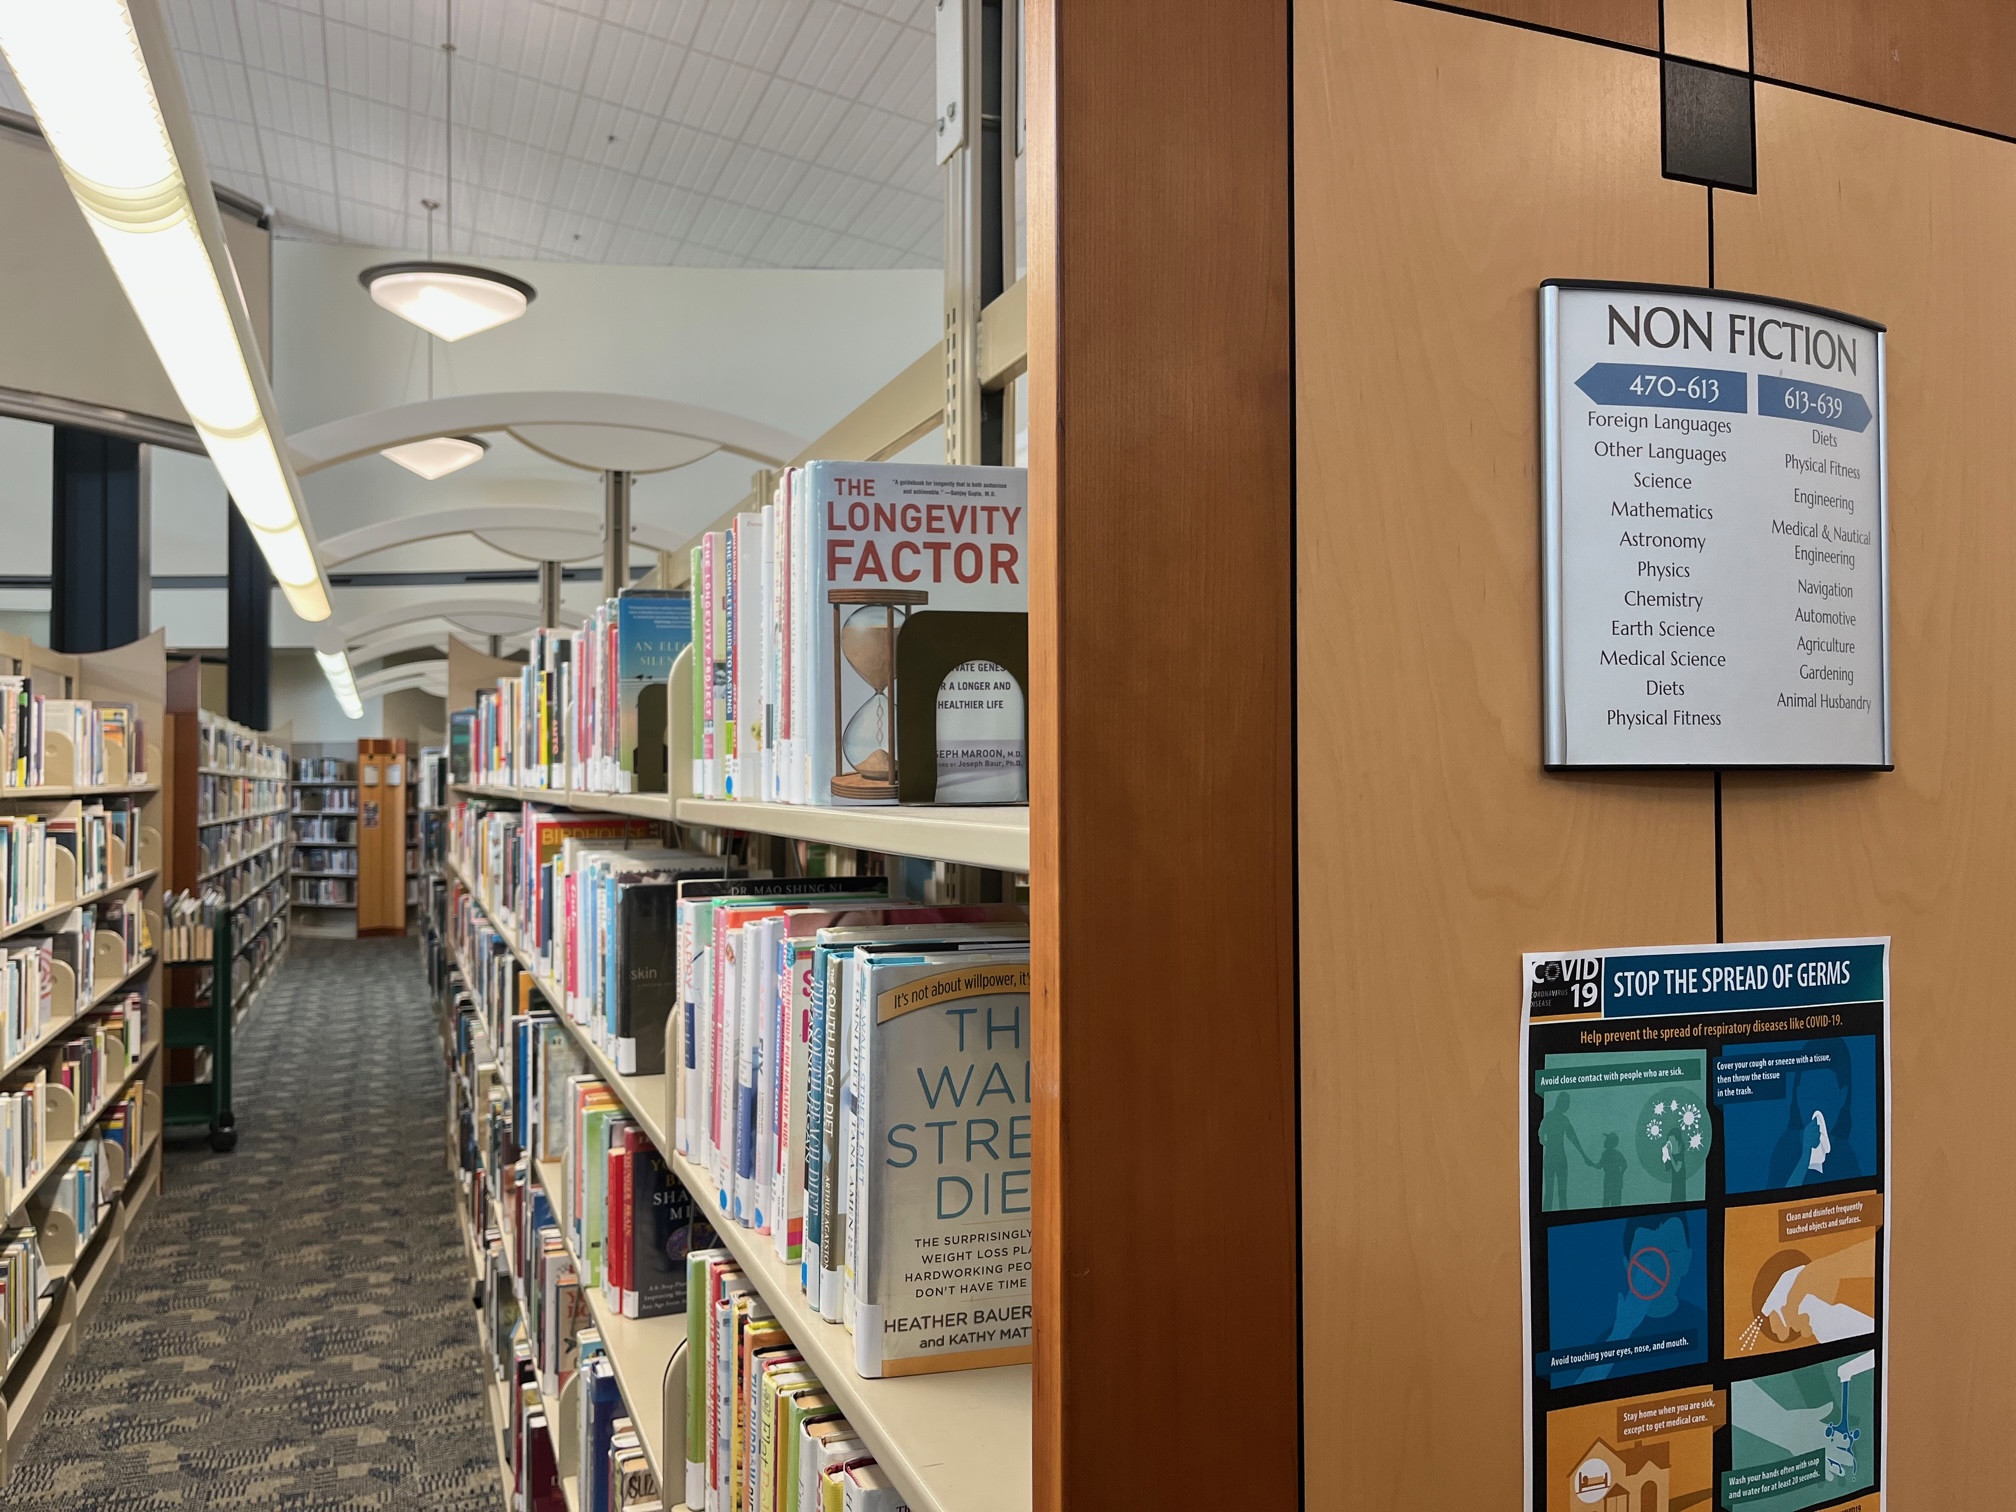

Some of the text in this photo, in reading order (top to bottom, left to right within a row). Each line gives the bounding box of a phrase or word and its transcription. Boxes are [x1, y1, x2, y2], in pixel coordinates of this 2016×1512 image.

[1608, 304, 1857, 376] NON FICTION
[1629, 375, 1719, 403] 470-613
[1784, 387, 1842, 419] 613-639
[1588, 411, 1732, 436] Foreign Languages
[1812, 429, 1837, 448] Diets
[1594, 441, 1727, 465] Other Languages
[1785, 453, 1860, 480] Physical Fitness
[834, 478, 875, 496] THE
[1634, 472, 1692, 490] Science
[1611, 501, 1713, 520] Mathematics
[1794, 488, 1854, 514] Engineering
[827, 501, 1022, 535] LONGEVITY
[1620, 532, 1706, 553] Astronomy
[1771, 520, 1871, 546] Medical & Nautical
[827, 540, 1019, 584] FACTOR
[1795, 546, 1855, 570] Engineering
[1638, 561, 1690, 581] Physics
[1798, 579, 1853, 600] Navigation
[1624, 591, 1703, 611] Chemistry
[1795, 607, 1856, 626] Automotive
[1612, 621, 1715, 638] Earth Science
[1797, 636, 1855, 654] Agriculture
[978, 663, 1005, 672] GENES
[1600, 650, 1726, 667] Medical Science
[1799, 665, 1854, 685] Gardening
[941, 682, 1010, 690] R A LONGER AND
[1646, 680, 1685, 696] Diets
[938, 700, 1003, 709] HEALTHIER LIFE
[1777, 693, 1871, 714] Animal Husbandry
[1607, 710, 1721, 730] Physical Fitness
[962, 750, 1005, 758] MAROON,
[754, 885, 782, 896] MAO
[785, 884, 825, 894] SHING
[684, 922, 692, 988] HAPPY
[631, 966, 657, 980] skin
[1532, 958, 1599, 984] COVID
[1614, 960, 1850, 997] STOP THE SPREAD OF GERMS
[895, 993, 908, 1009] It's
[912, 987, 928, 1003] not
[932, 980, 961, 997] about
[964, 973, 1016, 990] willpower,
[1571, 982, 1598, 1007] 19
[827, 986, 836, 1041] SOUTH
[946, 1006, 1020, 1052] TH
[1580, 1015, 1843, 1045] Help prevent the spread of respiratory diseases like COVID-19.
[826, 1046, 835, 1098] BEACH
[1540, 1067, 1684, 1086] Avoid close contact with people who are sick.
[917, 1060, 1031, 1109] WAL
[824, 1101, 834, 1138] DIET
[886, 1115, 1031, 1168] STRE
[937, 1170, 1031, 1219] DIE
[1786, 1201, 1863, 1222] Clean and disinfect frequently
[1787, 1215, 1861, 1235] touched objects and surfaces.
[915, 1229, 1032, 1248] THE SURPRISINGLY
[922, 1251, 972, 1264] WEIGHT
[978, 1248, 1008, 1259] LOSS
[905, 1262, 1032, 1282] HARDWORKING PEO
[916, 1279, 1027, 1298] DON'T HAVE TIME
[884, 1306, 1032, 1333] HEATHER BAUER
[920, 1336, 944, 1348] and
[950, 1330, 997, 1345] KATHY
[1551, 1337, 1689, 1366] Avoid touching your eyes, nose, and mouth.
[1623, 1399, 1715, 1423] Stay home when you are sick,
[1624, 1413, 1707, 1436] except to get medical care.
